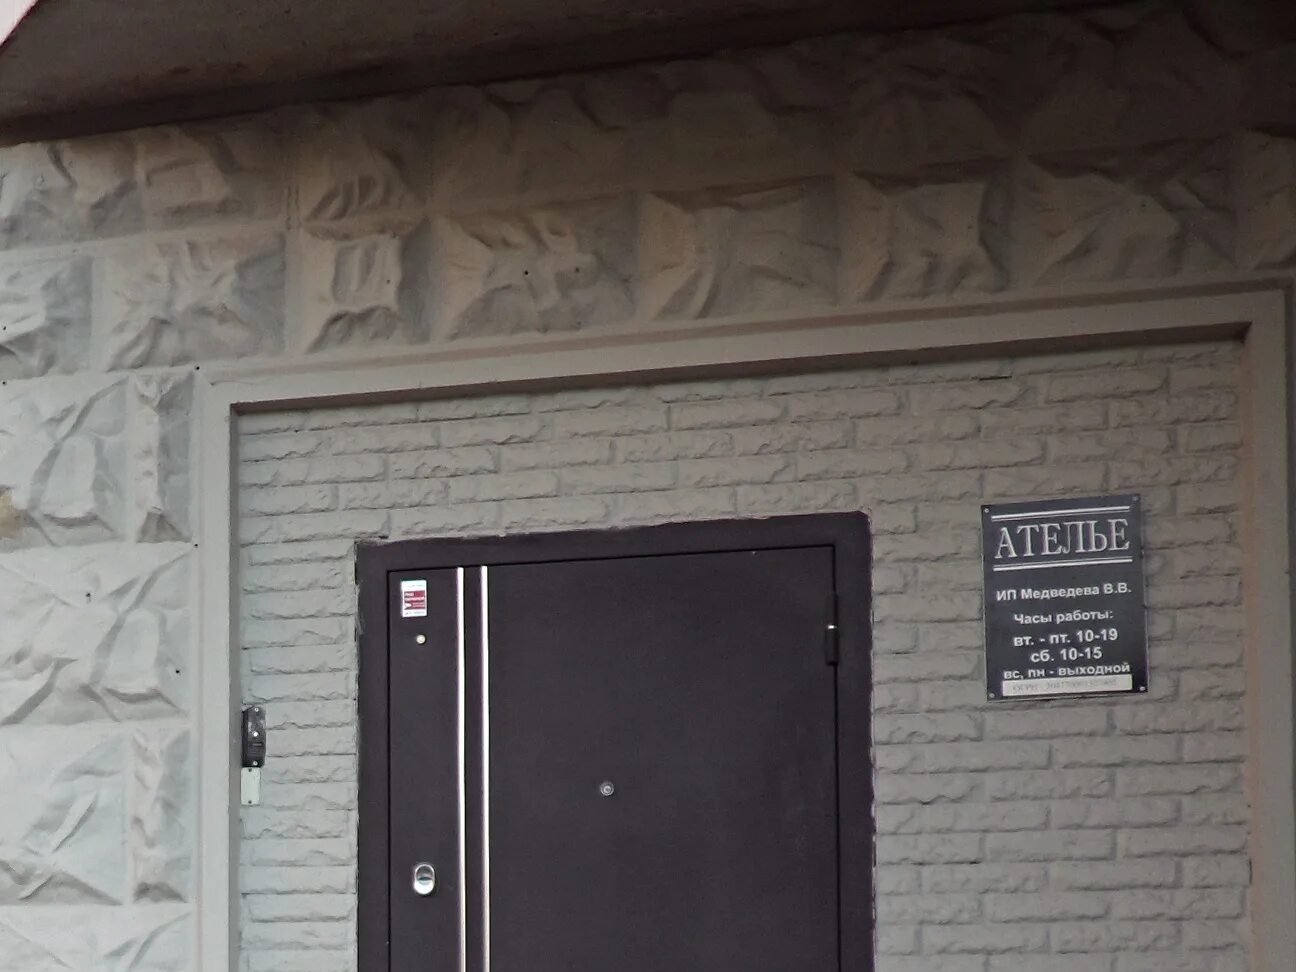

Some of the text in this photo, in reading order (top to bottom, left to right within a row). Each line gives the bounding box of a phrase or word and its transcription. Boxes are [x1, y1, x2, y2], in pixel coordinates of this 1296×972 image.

[994, 518, 1130, 559] АТЕЛЬЕ
[996, 582, 1132, 601] ИП Медведева В.В.
[1014, 609, 1114, 625] Часы работы:
[1013, 636, 1035, 647] вт.
[1049, 634, 1071, 644] пт.
[1076, 628, 1119, 642] 10-19
[1030, 646, 1103, 662] сб. 10-15
[1028, 668, 1045, 678] пн
[1058, 662, 1131, 676] выходной
